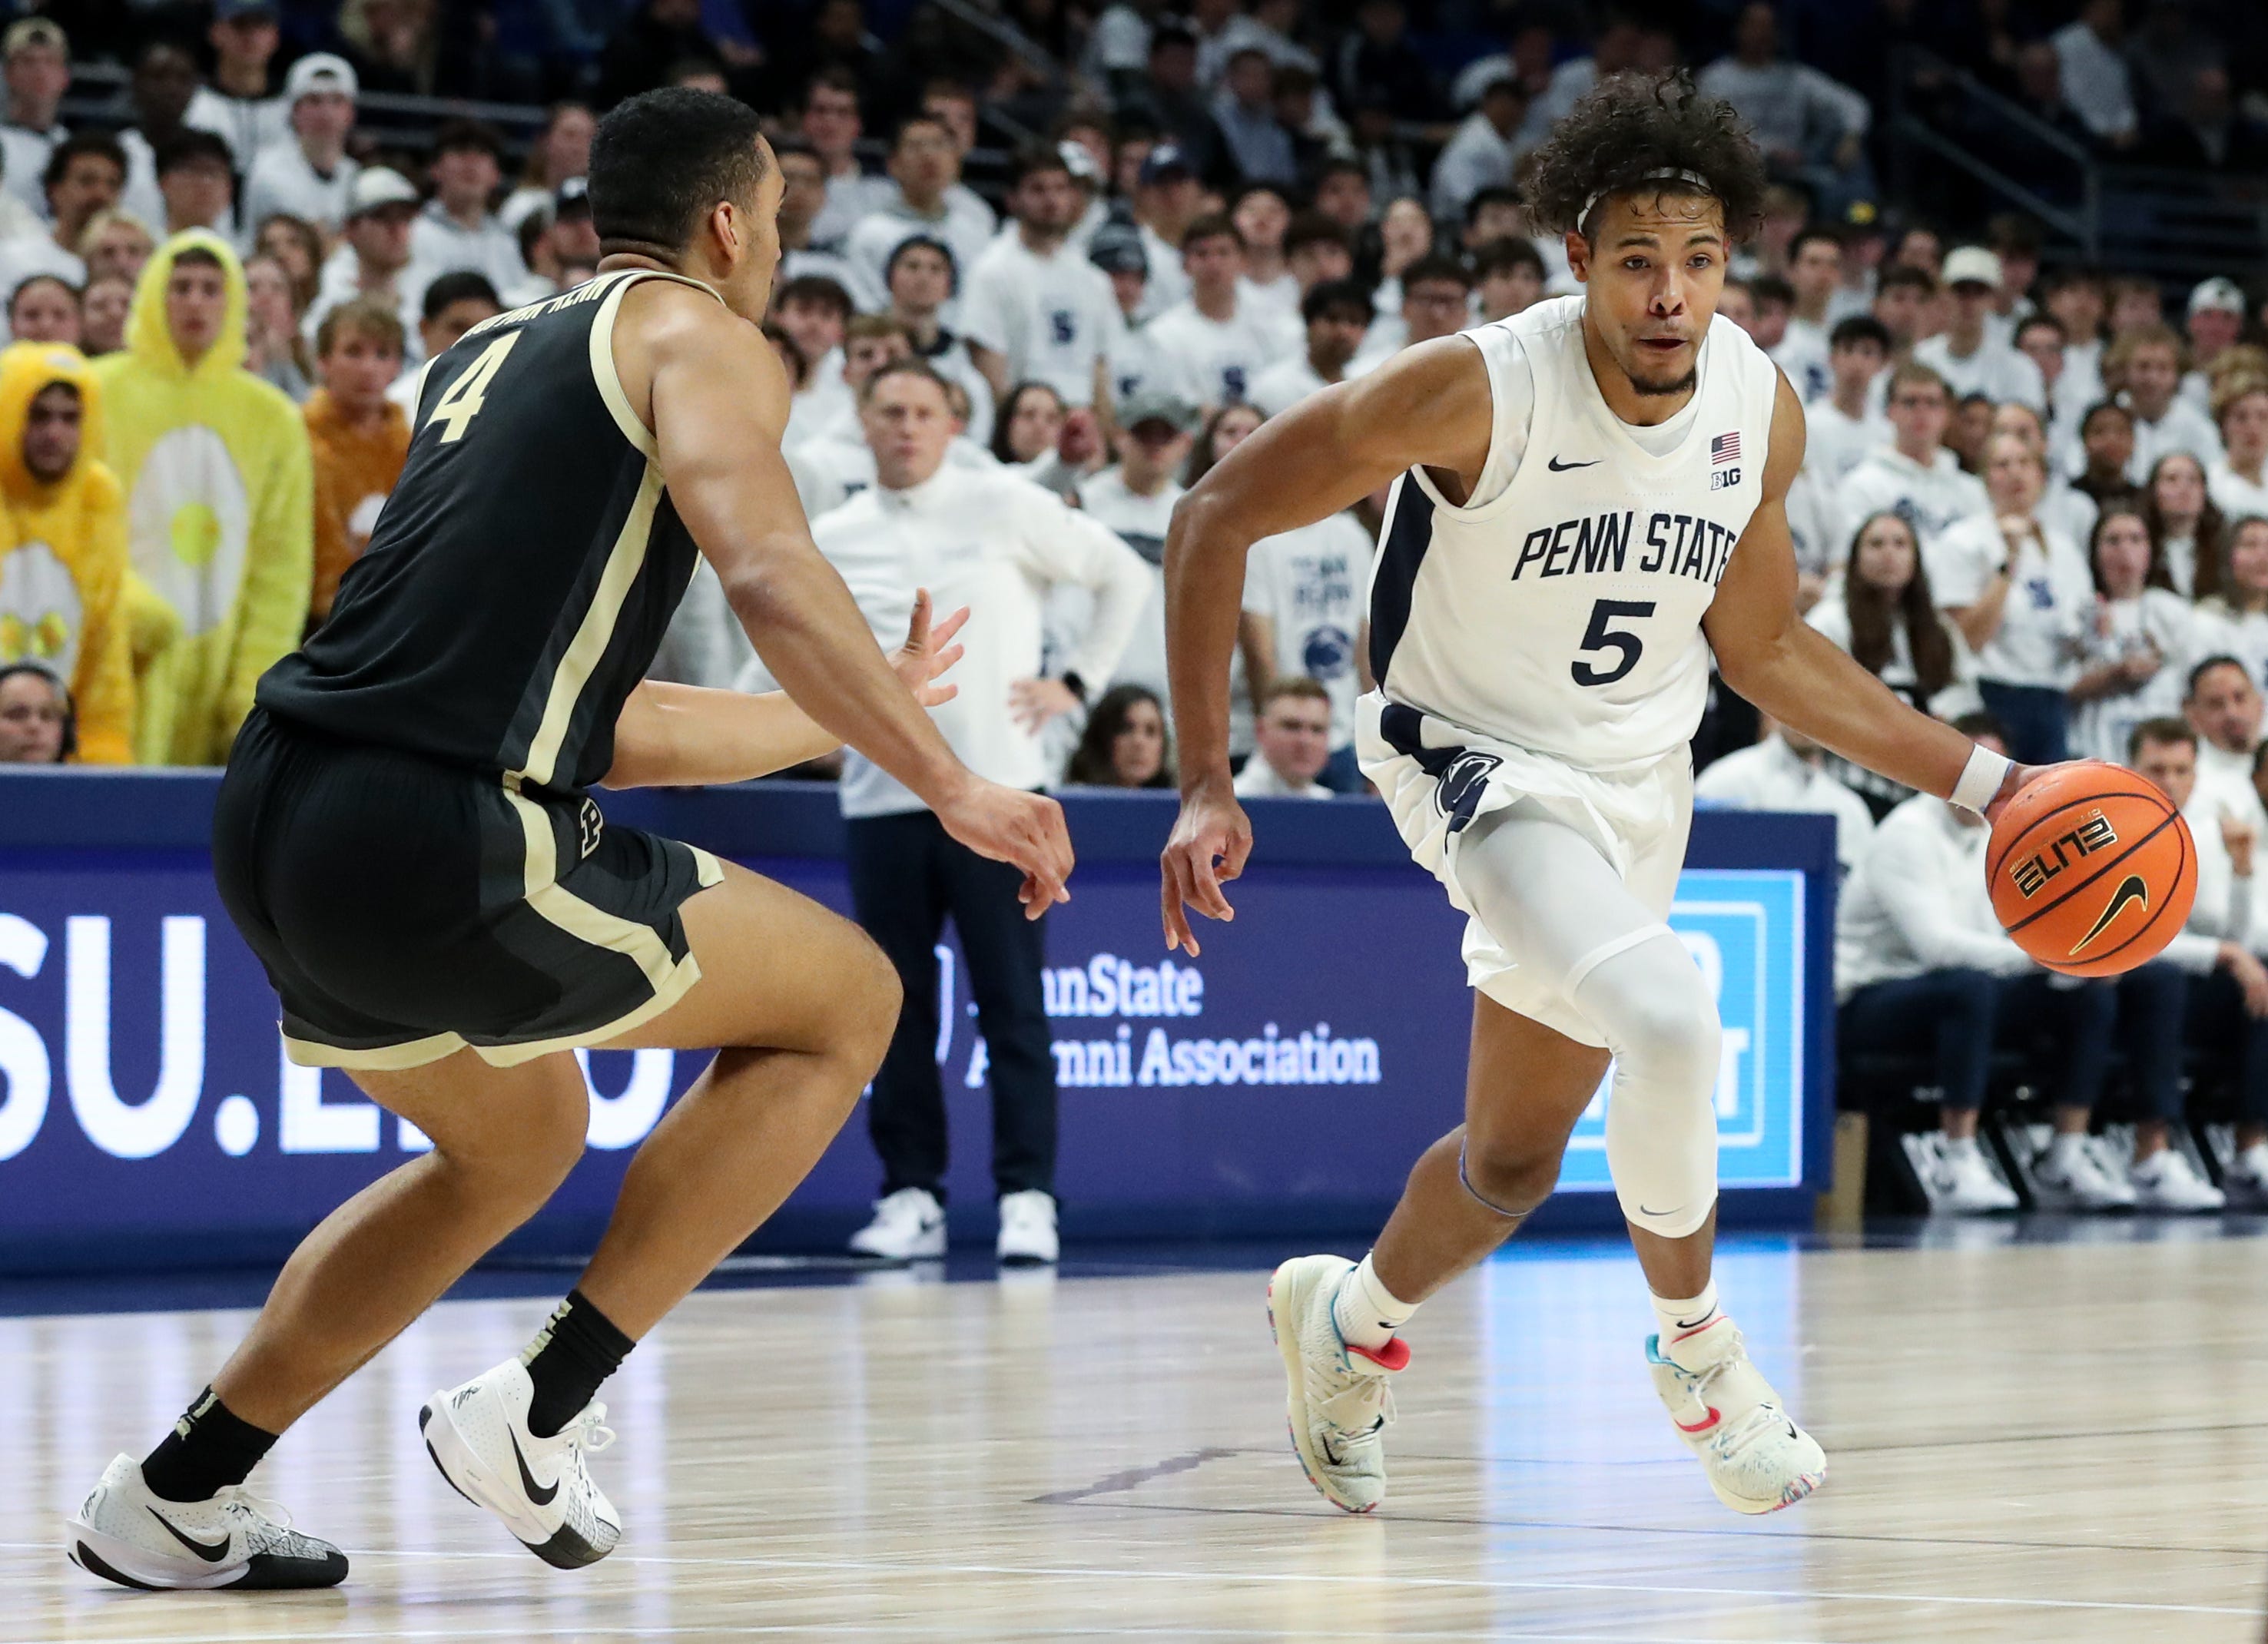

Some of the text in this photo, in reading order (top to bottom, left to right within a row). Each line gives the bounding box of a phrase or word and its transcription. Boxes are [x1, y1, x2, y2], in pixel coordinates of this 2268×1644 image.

[425, 330, 522, 443] 4
[1510, 511, 1634, 581] PENN
[1571, 598, 1656, 687] 5
[580, 797, 603, 859] P
[2012, 814, 2118, 900] ELITE
[967, 953, 1204, 1016] nState
[965, 1022, 1381, 1088] Amni Association
